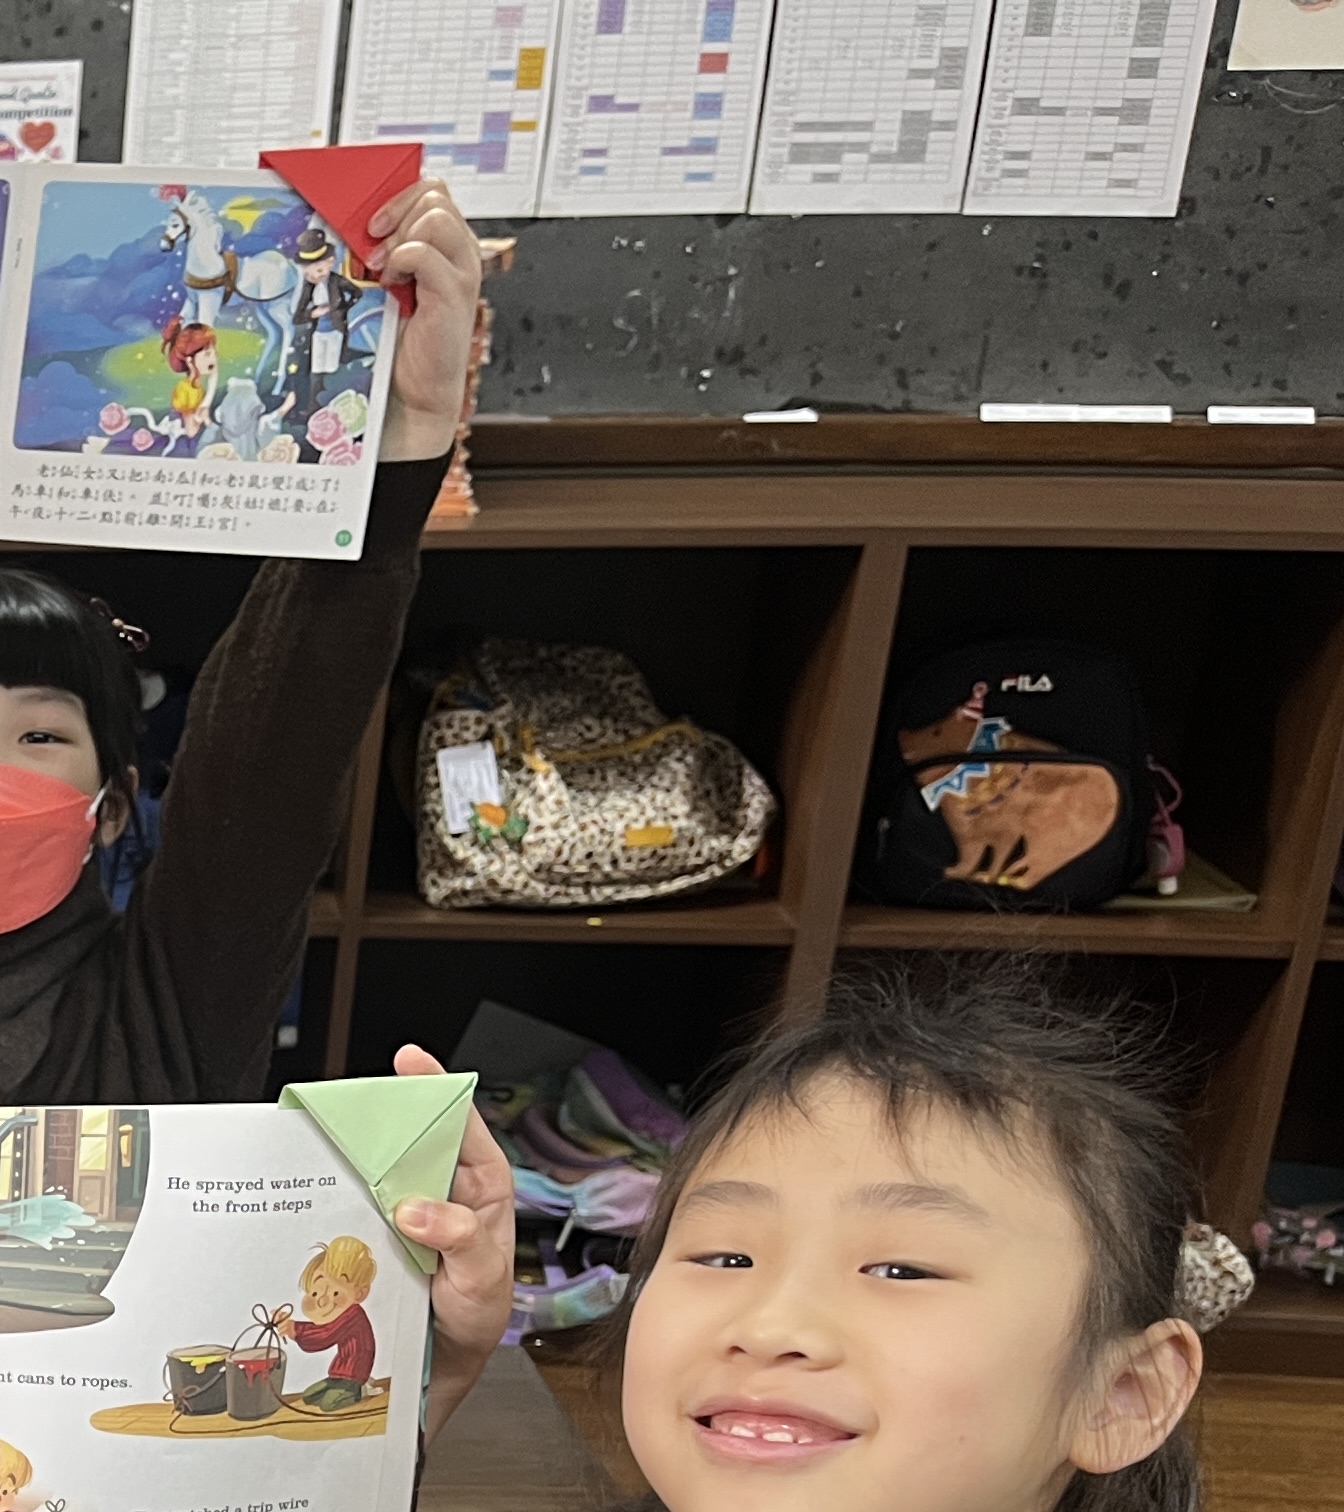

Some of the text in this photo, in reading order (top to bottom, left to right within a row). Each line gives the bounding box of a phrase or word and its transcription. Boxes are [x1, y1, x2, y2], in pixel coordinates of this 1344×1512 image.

[1001, 673, 1053, 692] FILA
[167, 1176, 336, 1193] He sprayed water on
[193, 1199, 312, 1213] the front steps
[17, 1374, 54, 1385] cans
[61, 1375, 75, 1386] to
[82, 1377, 133, 1391] ropes.
[279, 1498, 309, 1510] wire
